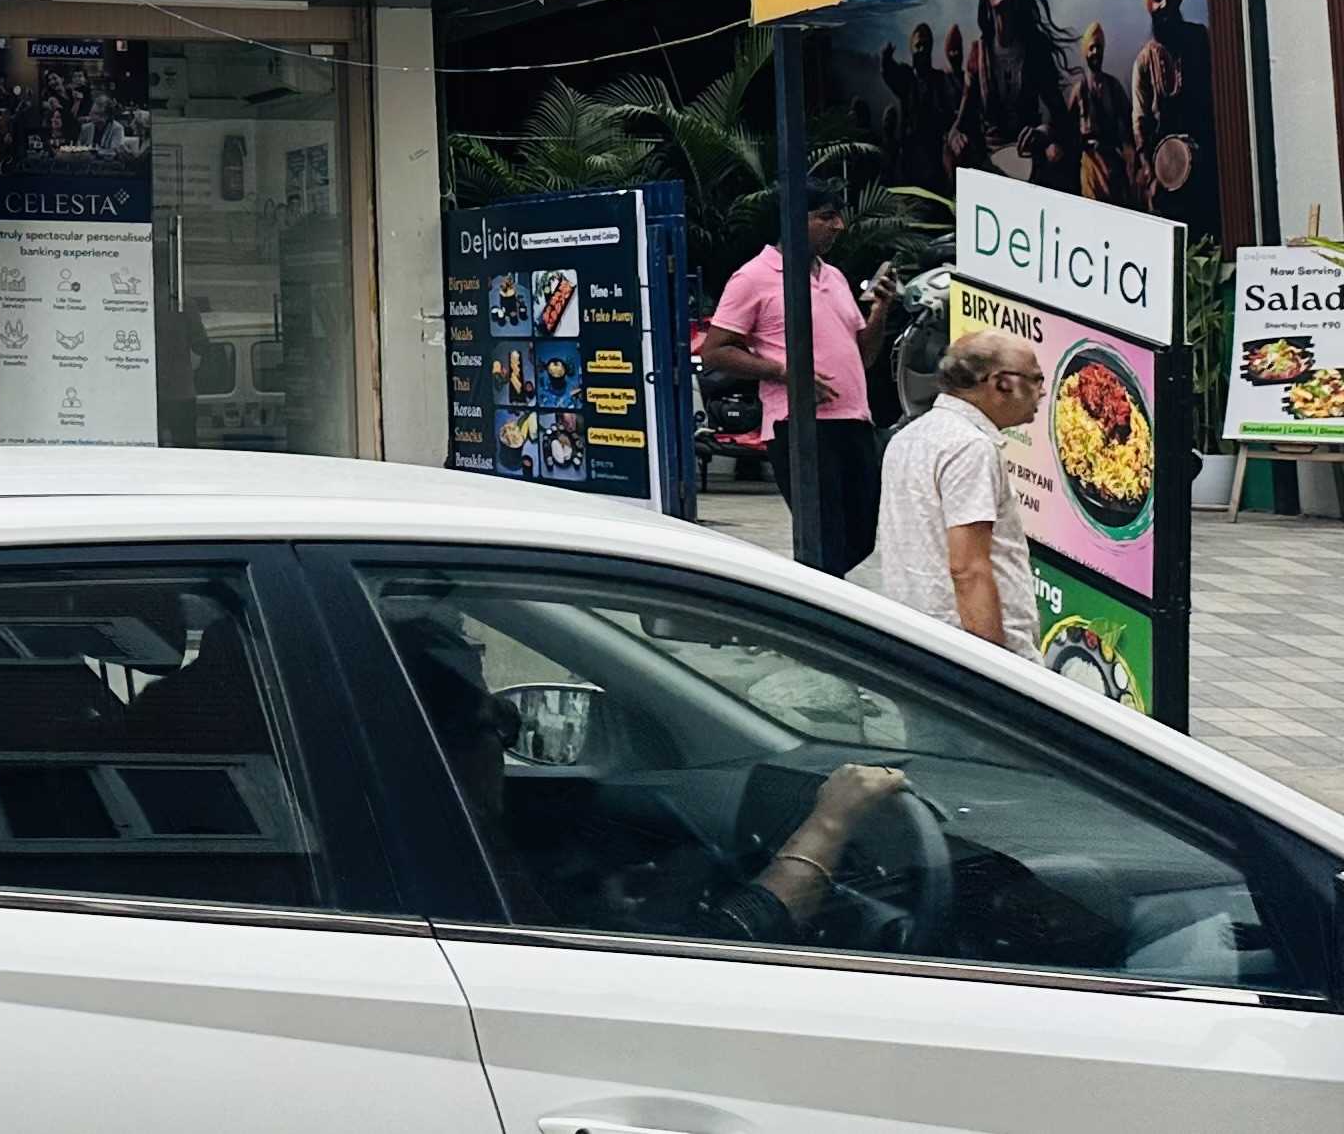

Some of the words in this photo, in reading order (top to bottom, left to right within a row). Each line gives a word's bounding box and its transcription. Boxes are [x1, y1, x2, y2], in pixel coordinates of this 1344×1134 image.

[31, 43, 71, 56] FEDERAL
[71, 45, 101, 57] BANK
[5, 192, 119, 216] CELESTA
[0, 230, 24, 242] truly
[25, 230, 84, 242] spectacular
[460, 217, 520, 260] Delicia
[19, 246, 62, 259] banking
[62, 247, 120, 259] experience
[975, 203, 1148, 309] Delicia
[1270, 266, 1296, 277] Now
[1297, 265, 1342, 278] Serving
[961, 290, 1044, 345] BIRYANIS
[451, 351, 483, 367] Chinese
[453, 401, 483, 418] Korean
[1017, 467, 1054, 494] BIRYANI
[1017, 490, 1041, 514] YANI
[1032, 566, 1063, 616] ing
